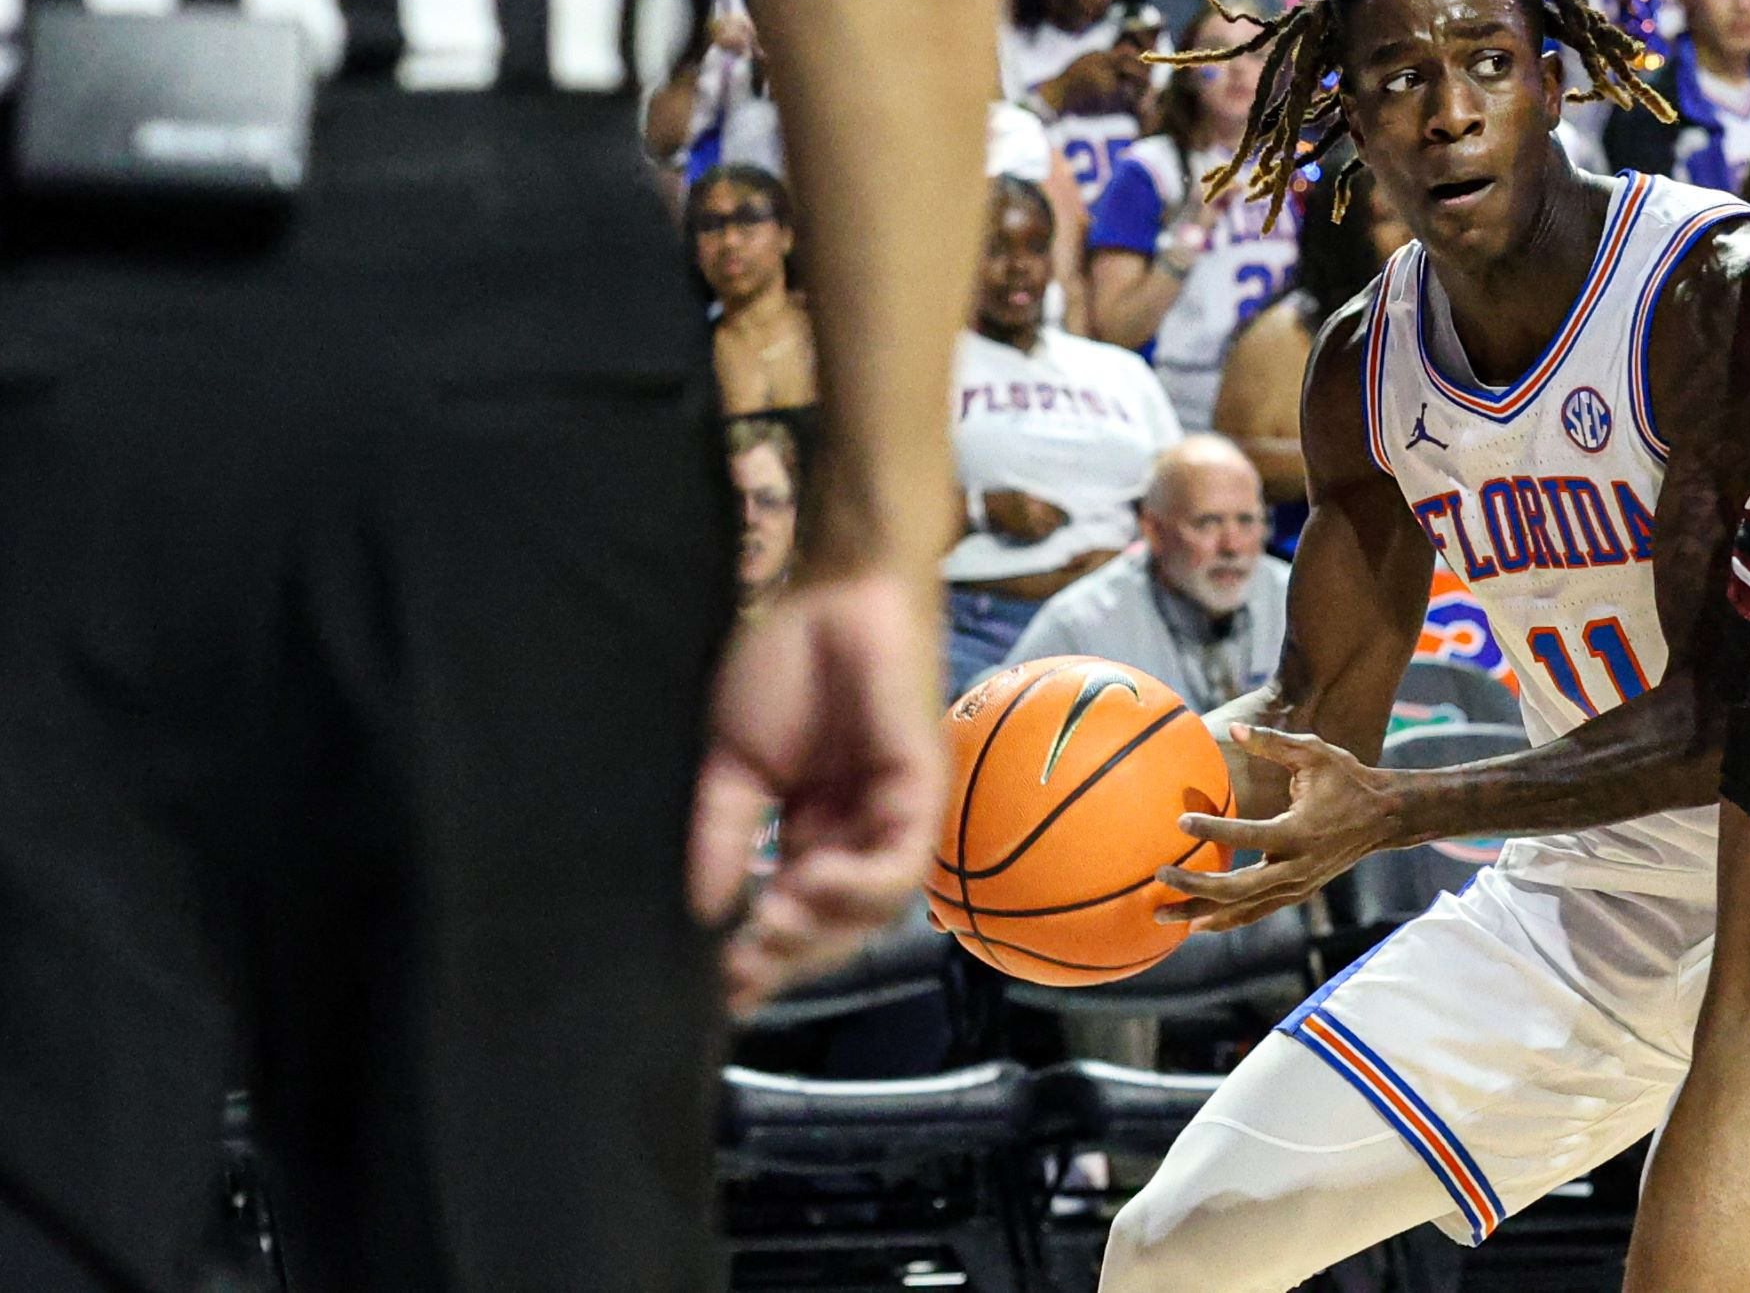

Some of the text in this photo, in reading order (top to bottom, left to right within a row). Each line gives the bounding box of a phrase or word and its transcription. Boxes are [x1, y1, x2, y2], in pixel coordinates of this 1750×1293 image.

[961, 382, 1130, 422] FLORIDA
[1564, 389, 1612, 451] SEC
[1412, 475, 1655, 583] FLORIDA
[1526, 616, 1652, 719] 11
